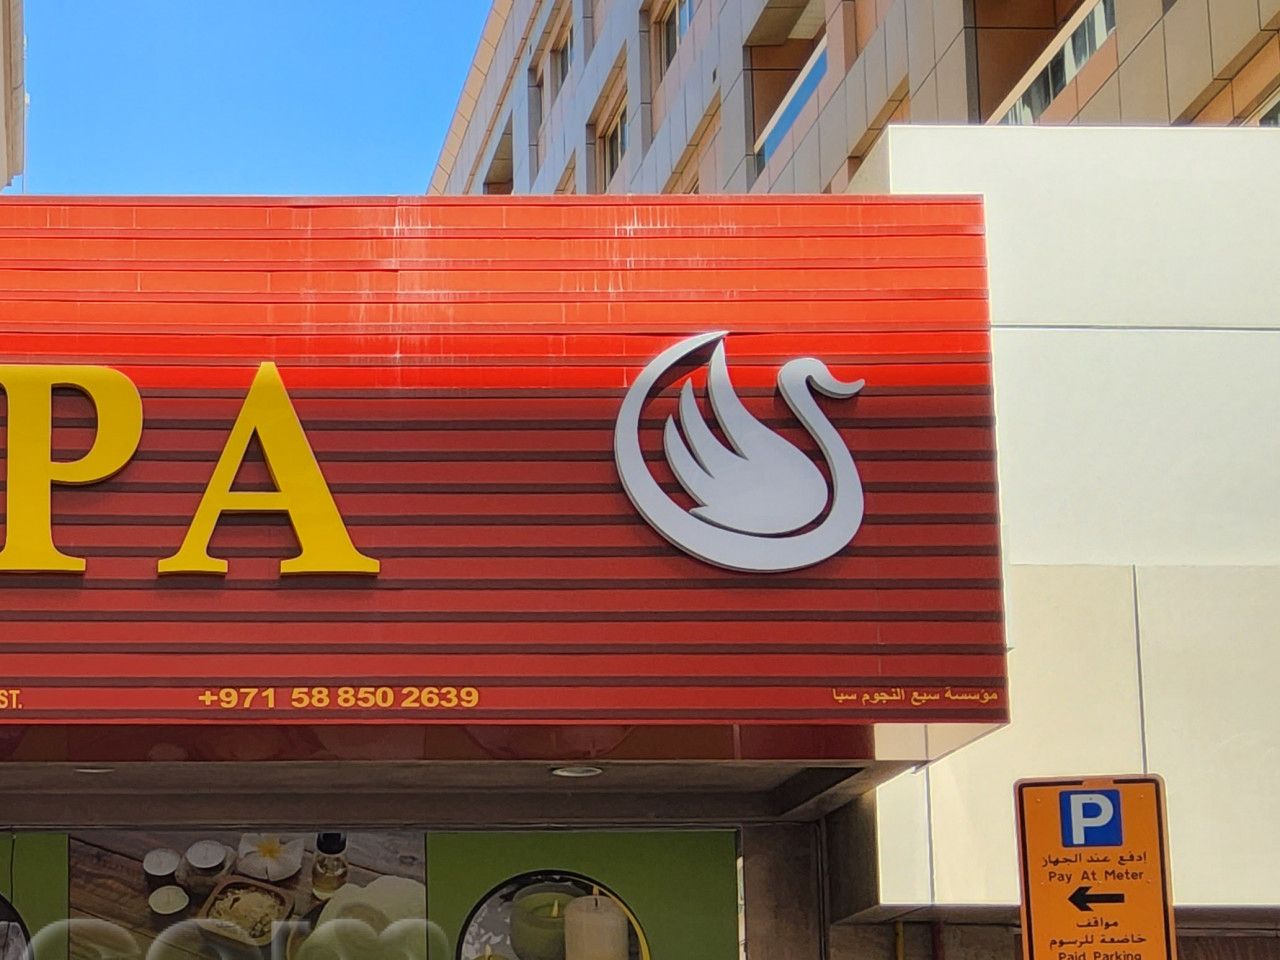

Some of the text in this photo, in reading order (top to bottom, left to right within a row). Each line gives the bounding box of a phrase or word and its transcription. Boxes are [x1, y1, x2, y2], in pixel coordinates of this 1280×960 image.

[198, 687, 480, 710] +971 58 850 2639
[1069, 792, 1114, 845] P
[1041, 852, 1082, 867] الجهاز
[1086, 853, 1110, 863] عند
[1048, 869, 1144, 883] Pay At Meter
[1076, 916, 1119, 930] مواقف
[1049, 933, 1147, 951] خاضعة للرسوم
